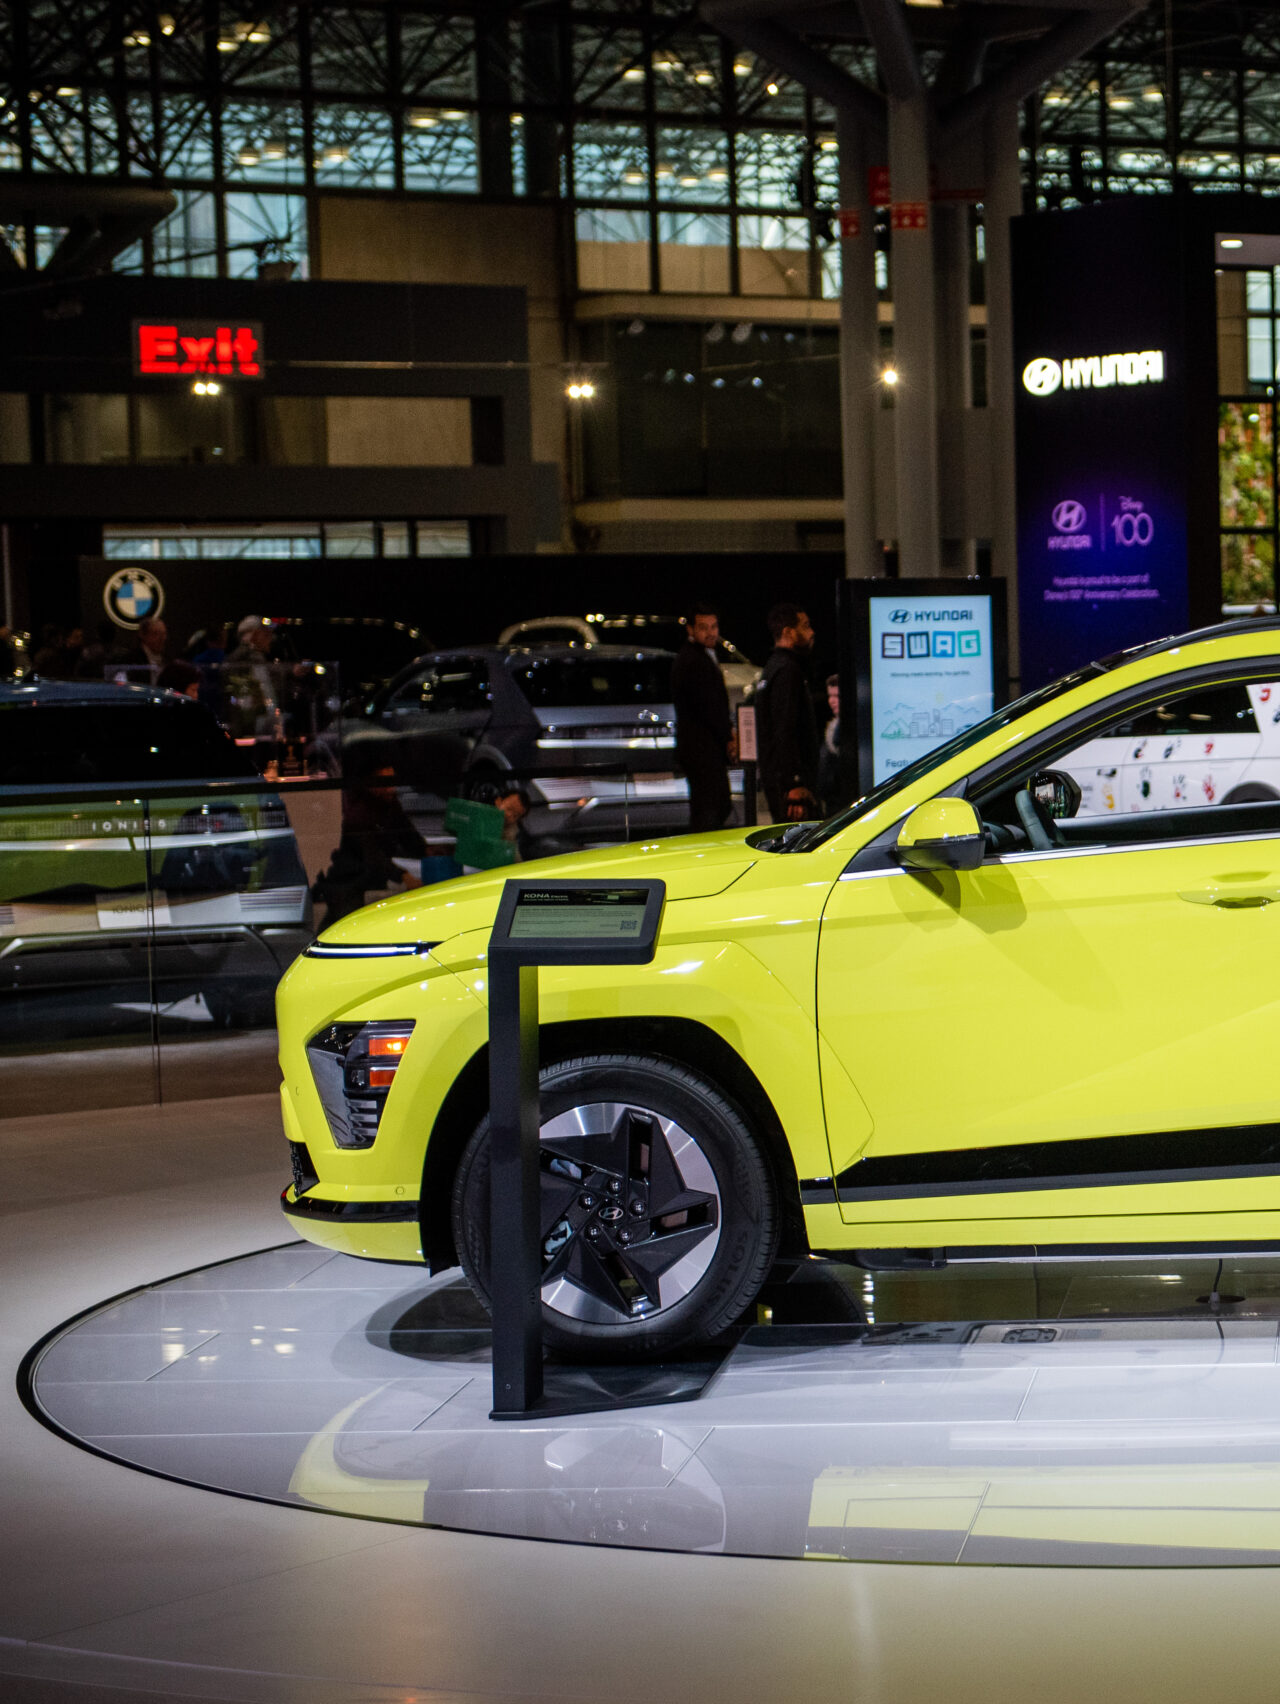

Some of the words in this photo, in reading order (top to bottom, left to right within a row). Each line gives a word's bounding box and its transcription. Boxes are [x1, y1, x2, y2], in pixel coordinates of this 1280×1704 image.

[138, 325, 259, 375] Exit
[1062, 350, 1164, 390] HYUNDAI
[1047, 535, 1092, 550] HYUNDAI
[1111, 512, 1153, 547] 100
[914, 610, 973, 621] HYUNDAI
[882, 630, 981, 658] SWAG
